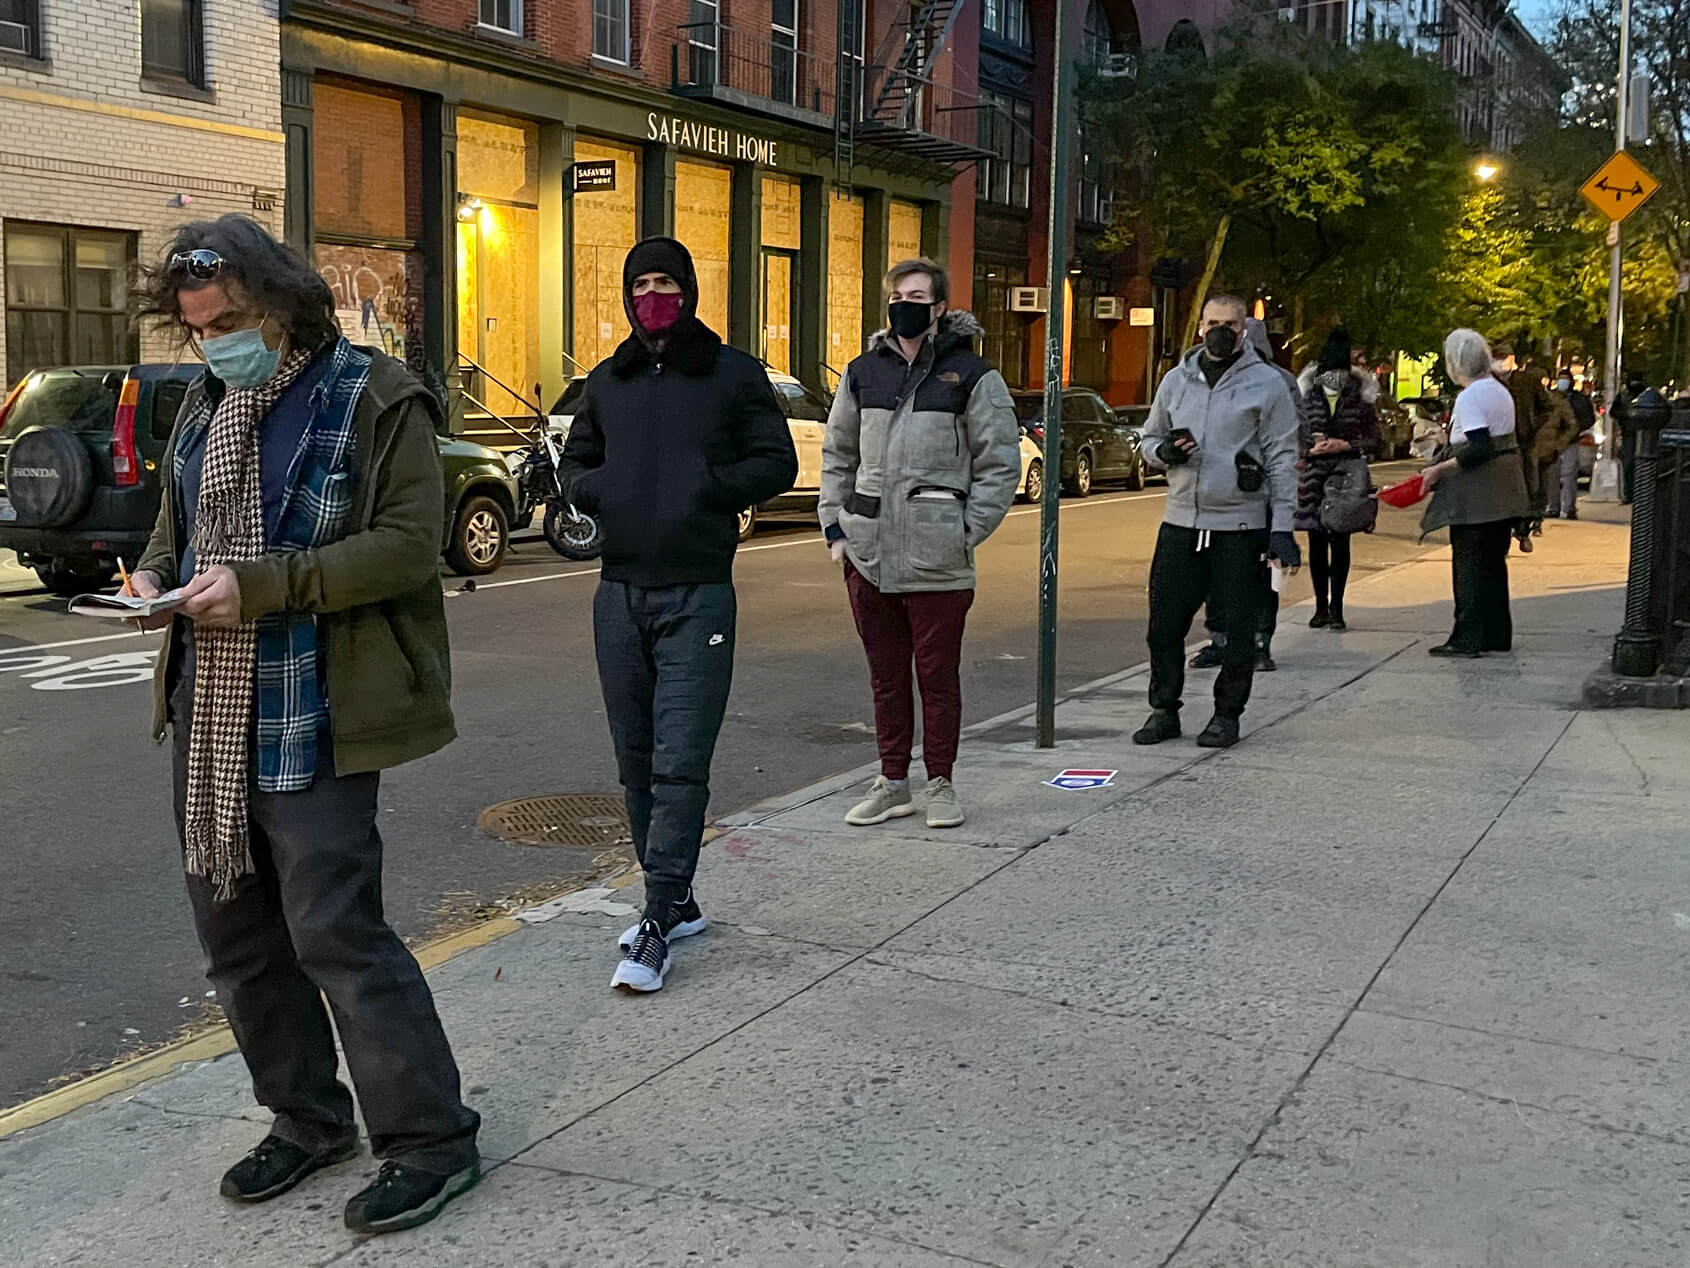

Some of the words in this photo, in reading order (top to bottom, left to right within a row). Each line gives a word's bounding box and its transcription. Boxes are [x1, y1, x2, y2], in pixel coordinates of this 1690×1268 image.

[648, 112, 728, 156] SAFAVIEH
[737, 133, 777, 166] HOME
[12, 467, 60, 478] HONDA
